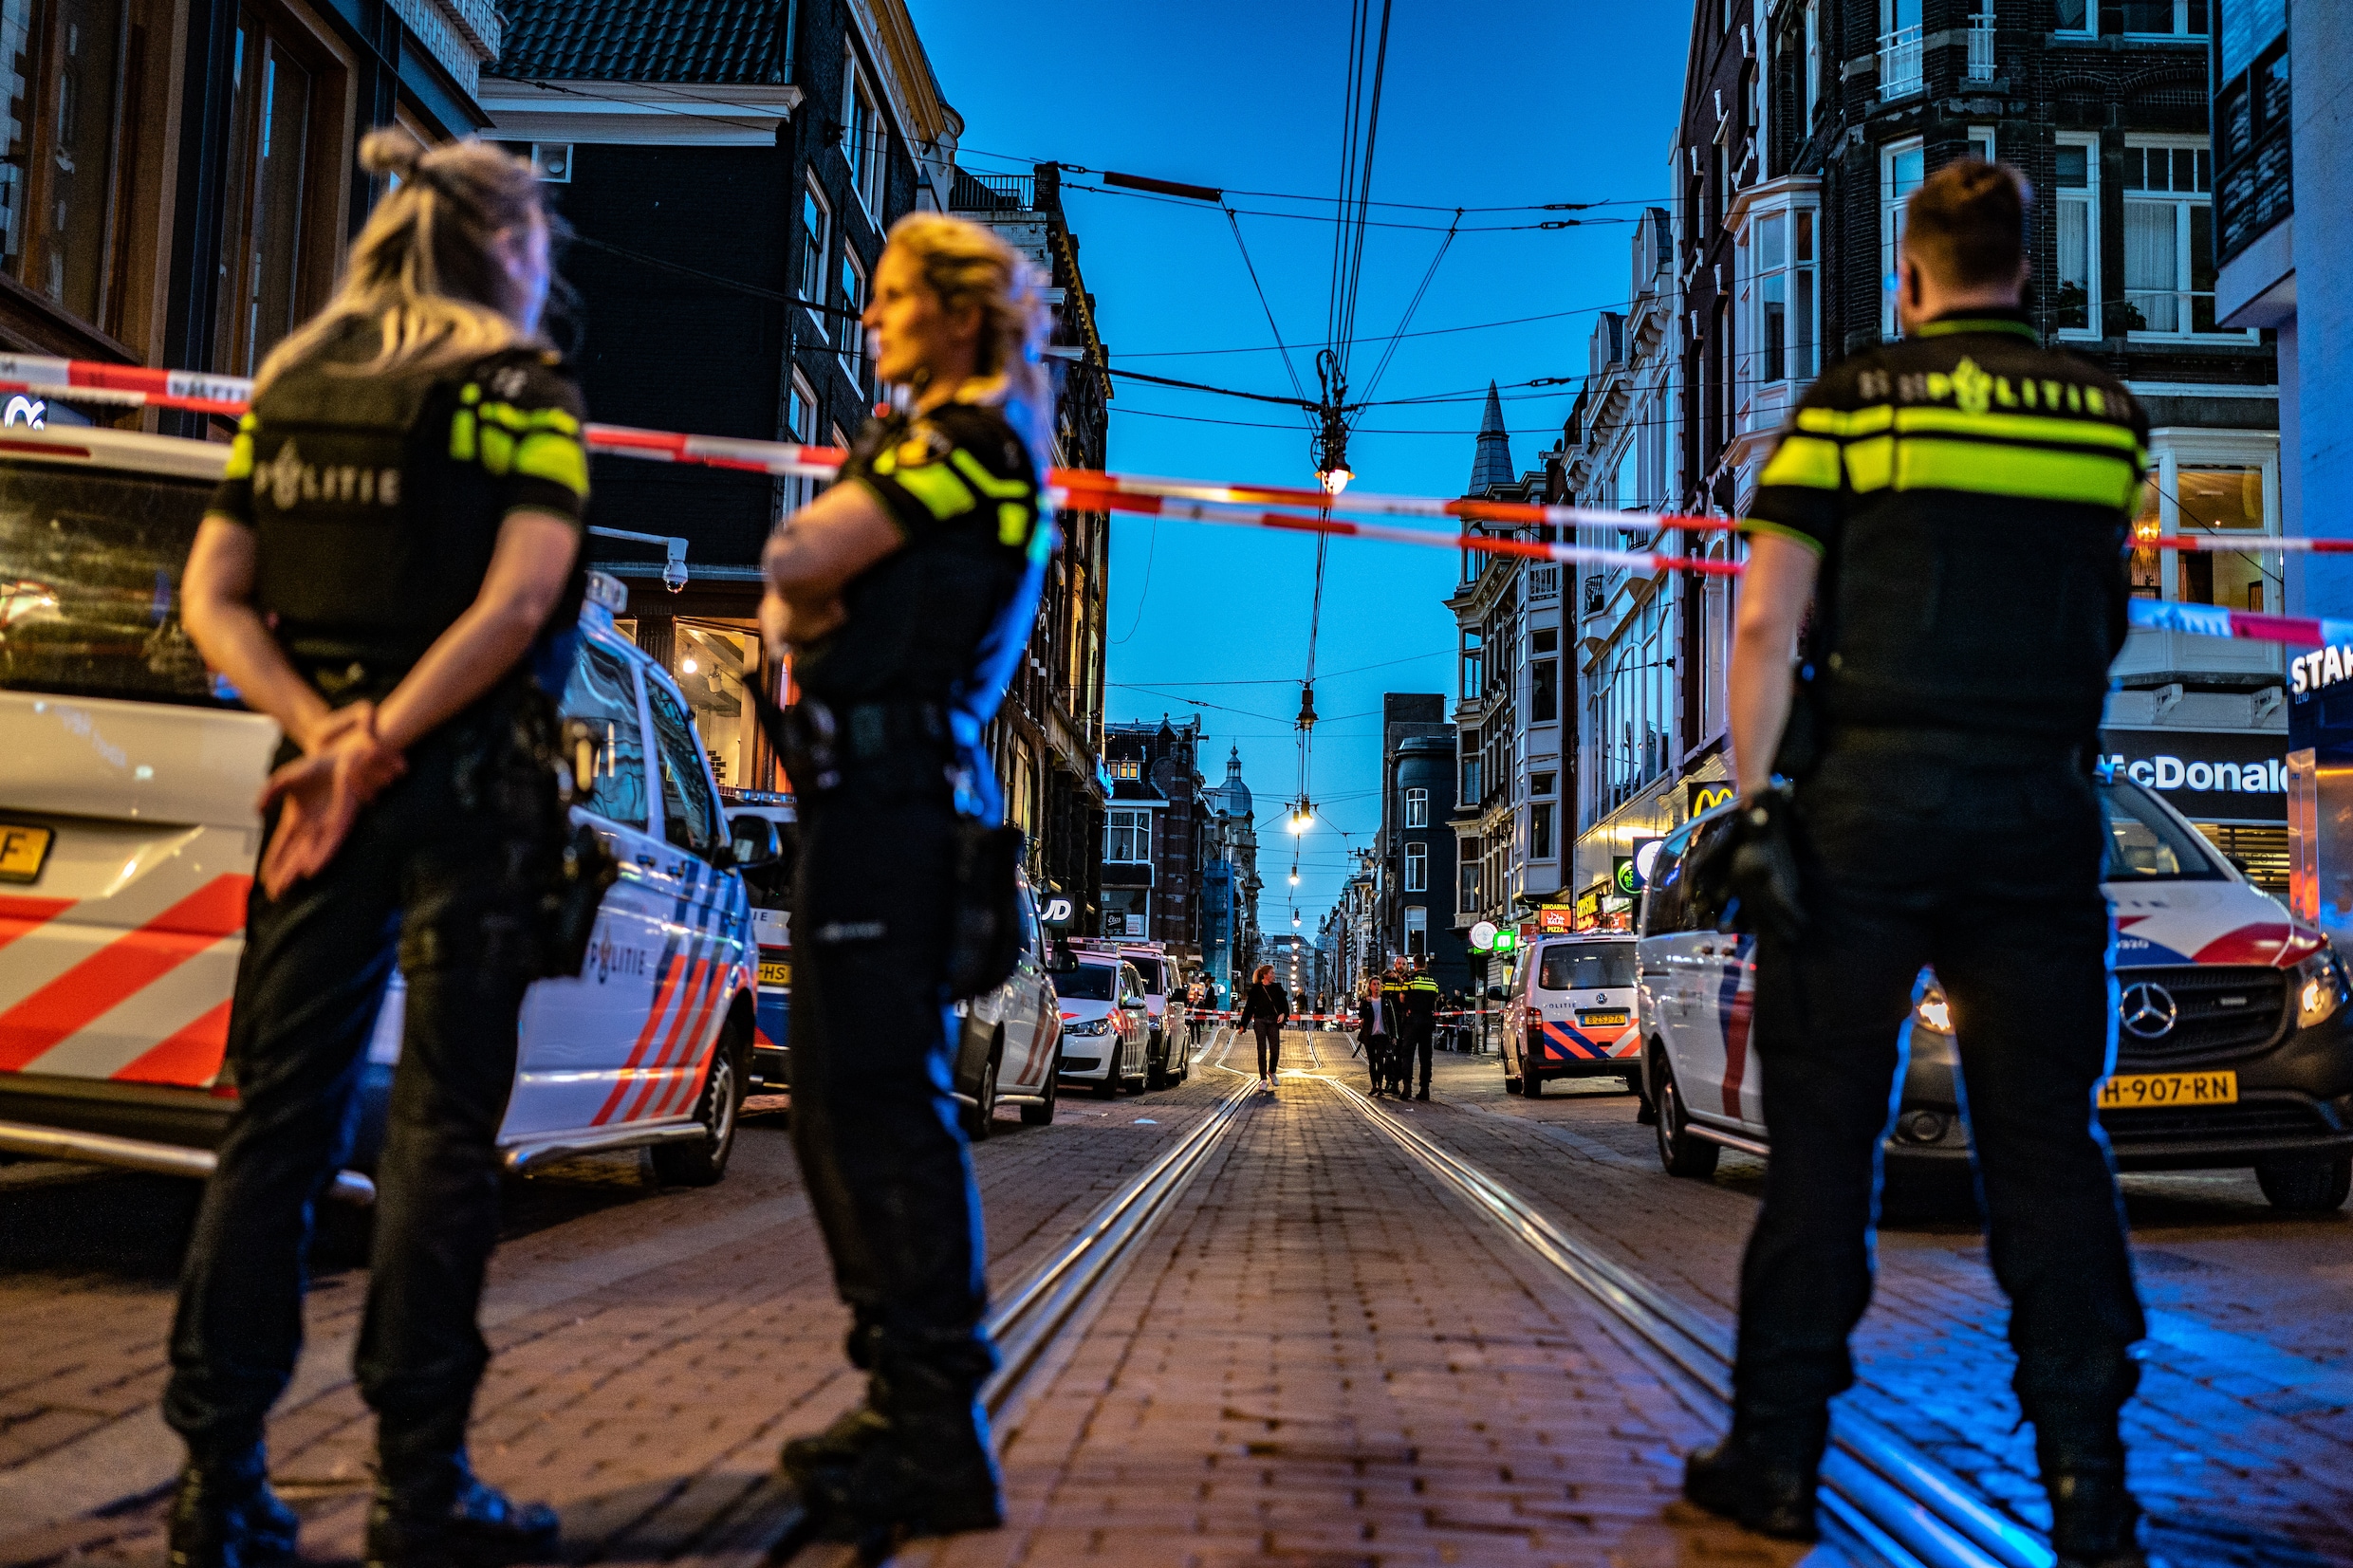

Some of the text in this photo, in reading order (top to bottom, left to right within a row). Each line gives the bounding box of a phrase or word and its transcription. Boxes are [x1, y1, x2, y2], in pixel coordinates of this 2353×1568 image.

[1042, 899, 1072, 920] JD
[1108, 914, 1121, 926] Etos
[2103, 1076, 2230, 1103] H-907-RN
